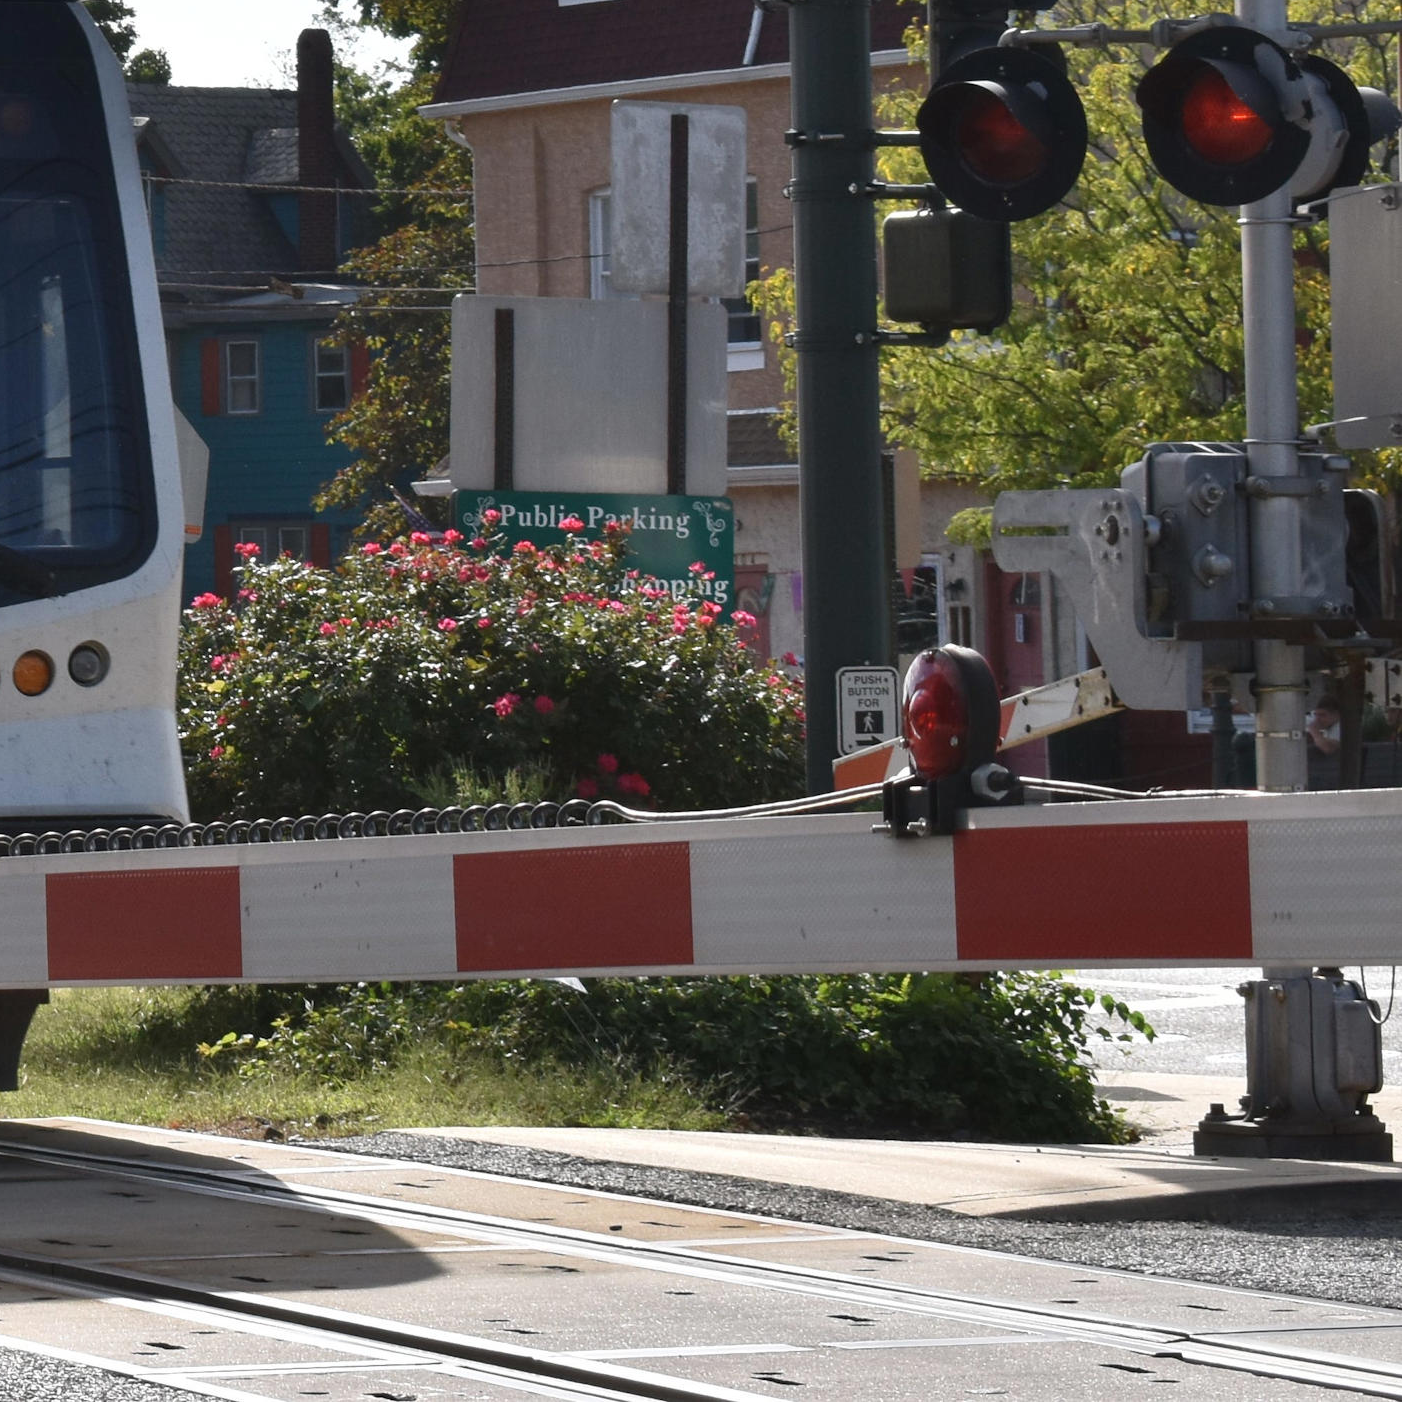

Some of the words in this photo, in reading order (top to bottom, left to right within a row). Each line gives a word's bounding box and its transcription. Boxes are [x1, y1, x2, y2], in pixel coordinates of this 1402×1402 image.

[586, 506, 691, 539] Parking
[853, 675, 882, 685] PUSH
[848, 687, 890, 696] BUTTON
[858, 698, 880, 708] FOR
